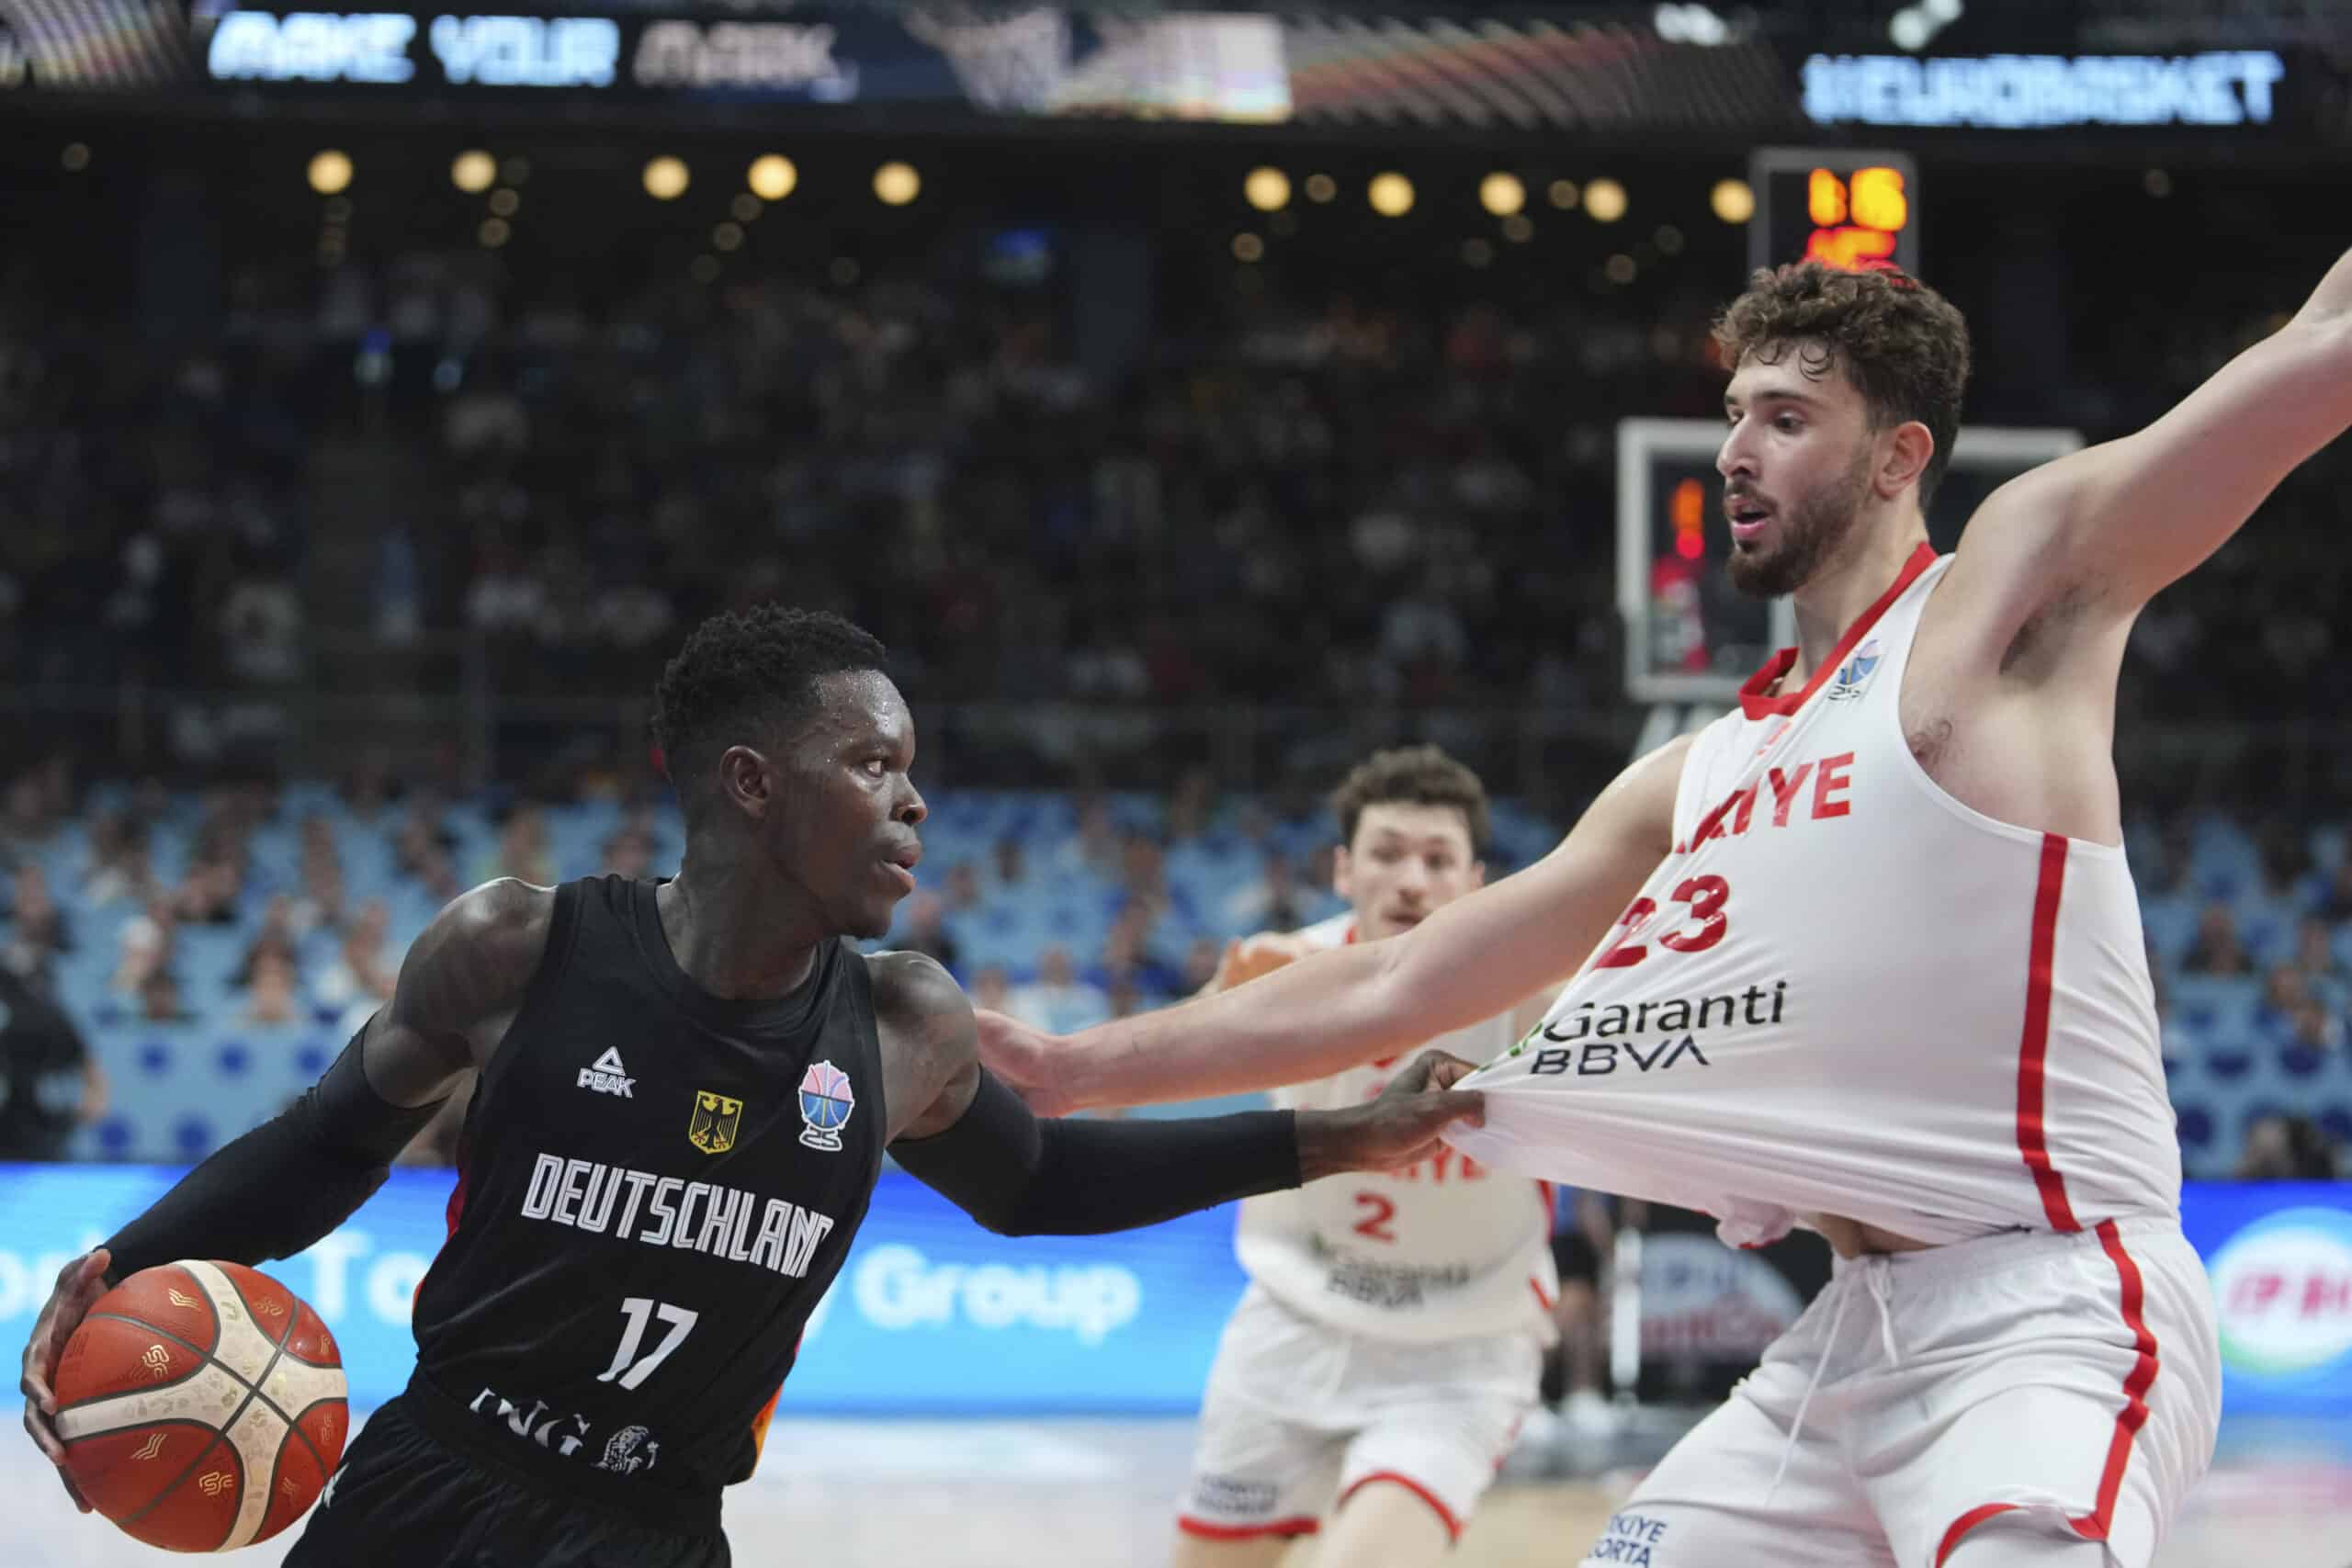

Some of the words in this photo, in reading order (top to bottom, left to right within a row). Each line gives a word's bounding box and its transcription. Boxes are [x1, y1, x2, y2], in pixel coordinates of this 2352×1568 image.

[430, 15, 620, 87] YOUR
[1592, 874, 1730, 971] 23
[1544, 981, 1787, 1042] Garanti
[577, 1067, 637, 1099] PEAK
[1530, 1034, 1711, 1076] BBVA
[1352, 1191, 1396, 1243] 2
[853, 1246, 1142, 1344] Group
[596, 1297, 699, 1391] 17
